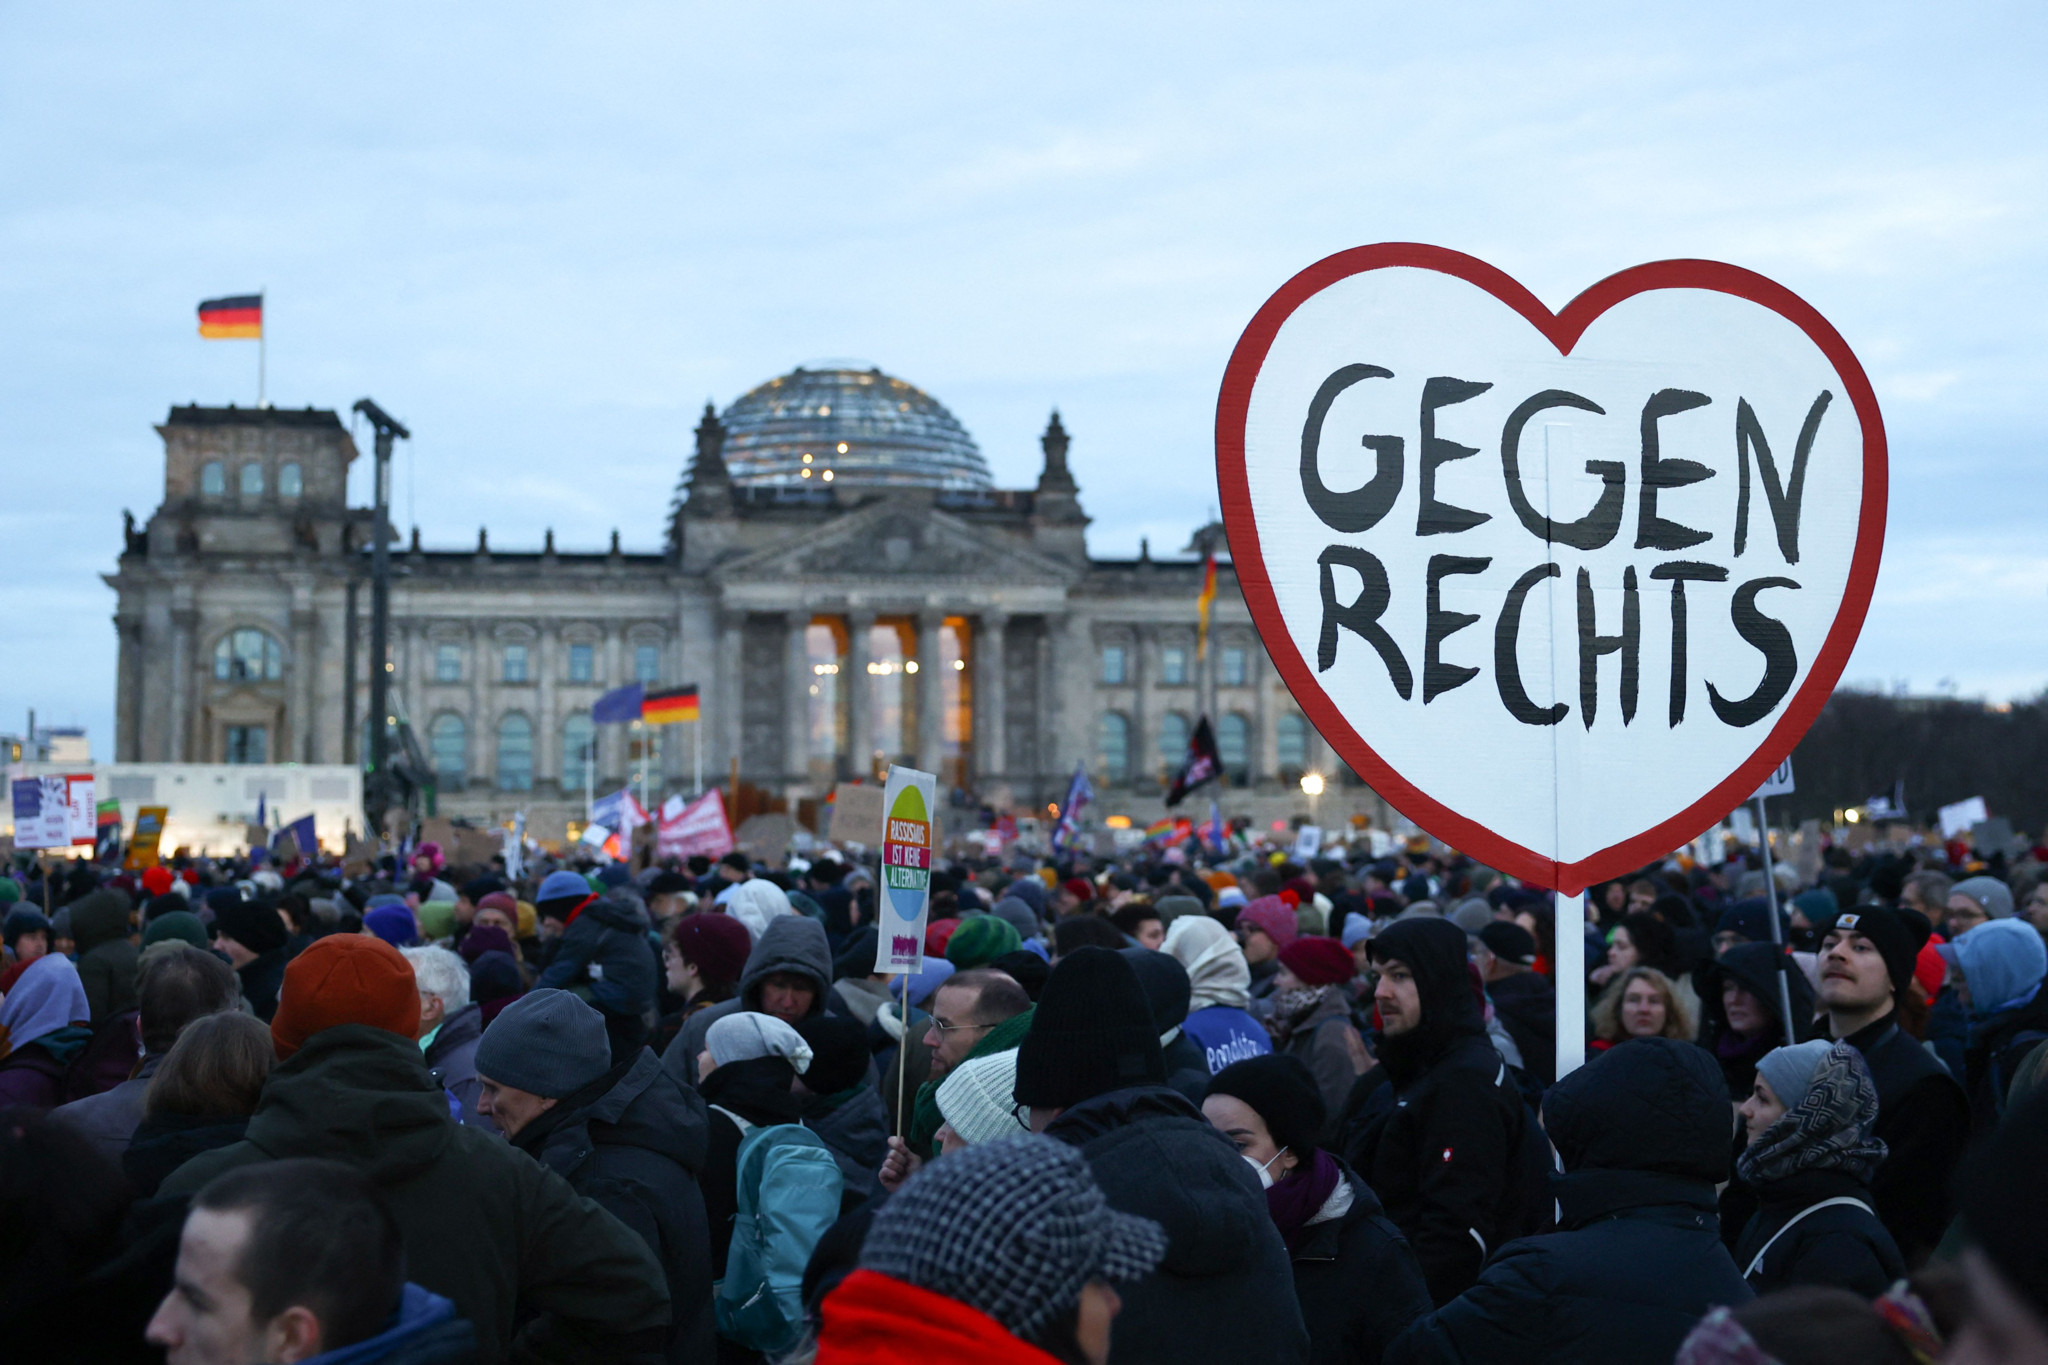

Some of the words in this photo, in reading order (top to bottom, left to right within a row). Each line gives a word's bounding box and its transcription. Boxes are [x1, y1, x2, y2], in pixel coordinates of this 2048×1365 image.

[1300, 363, 1832, 565] GEGEN
[1317, 545, 1801, 732] RECHTS
[890, 819, 925, 845] RASSISMUS
[892, 843, 903, 865] IST
[890, 866, 927, 889] ALTERNATIVE
